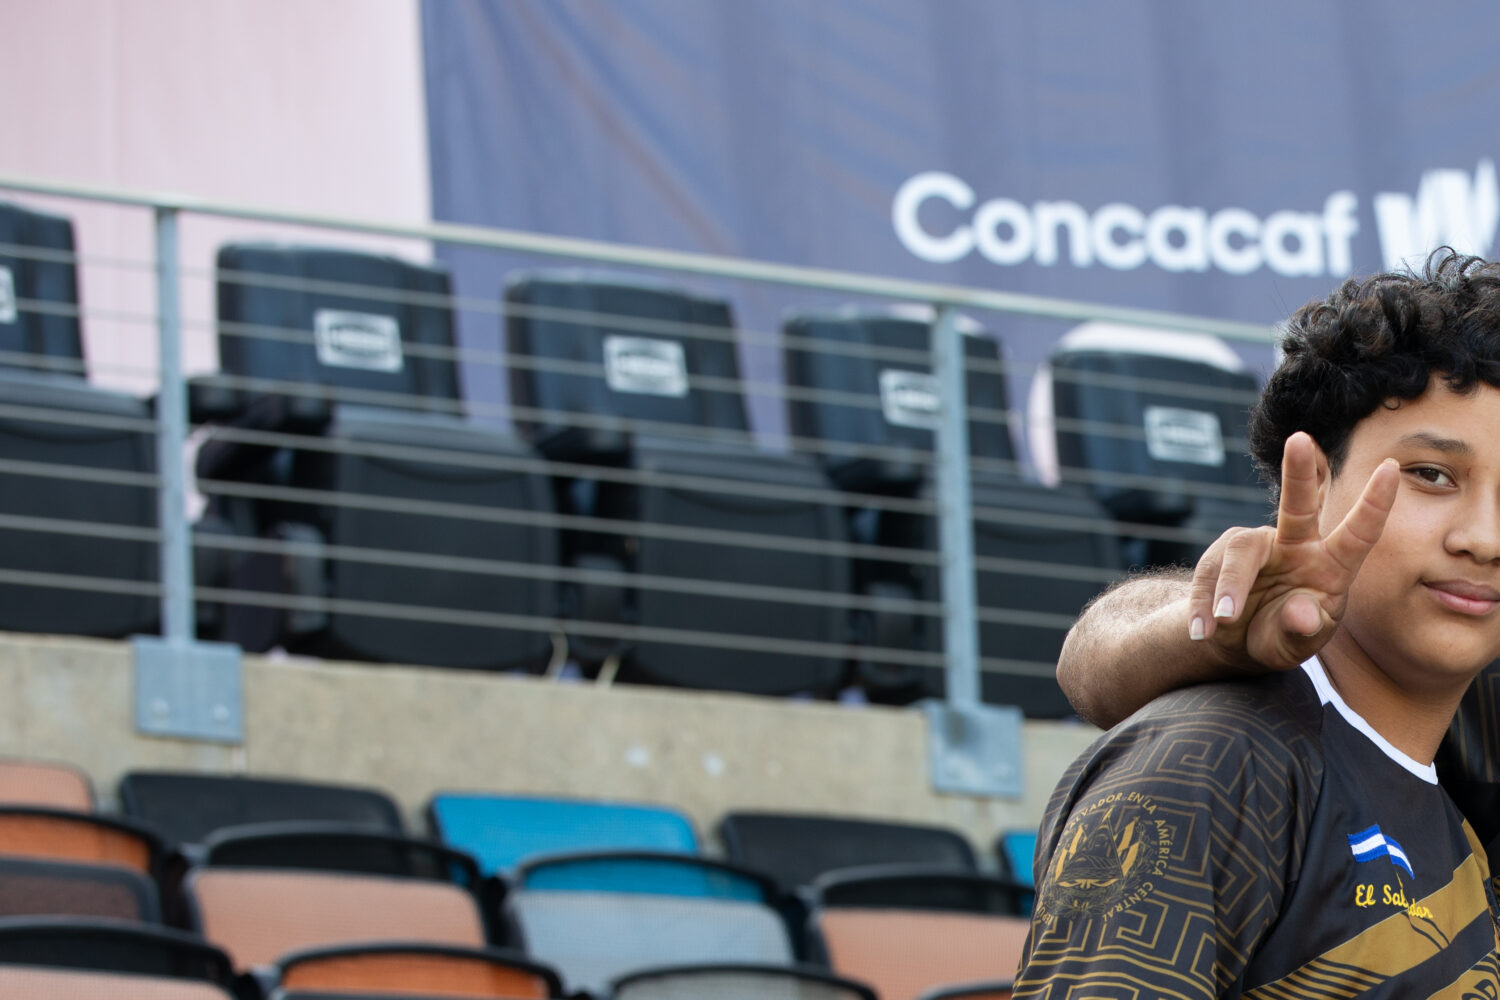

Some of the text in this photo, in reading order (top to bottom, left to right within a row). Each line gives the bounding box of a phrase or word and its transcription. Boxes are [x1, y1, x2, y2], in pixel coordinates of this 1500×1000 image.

[893, 171, 1359, 278] Concacaf
[1152, 819, 1173, 876] AMÉRICA
[1355, 884, 1376, 906] El
